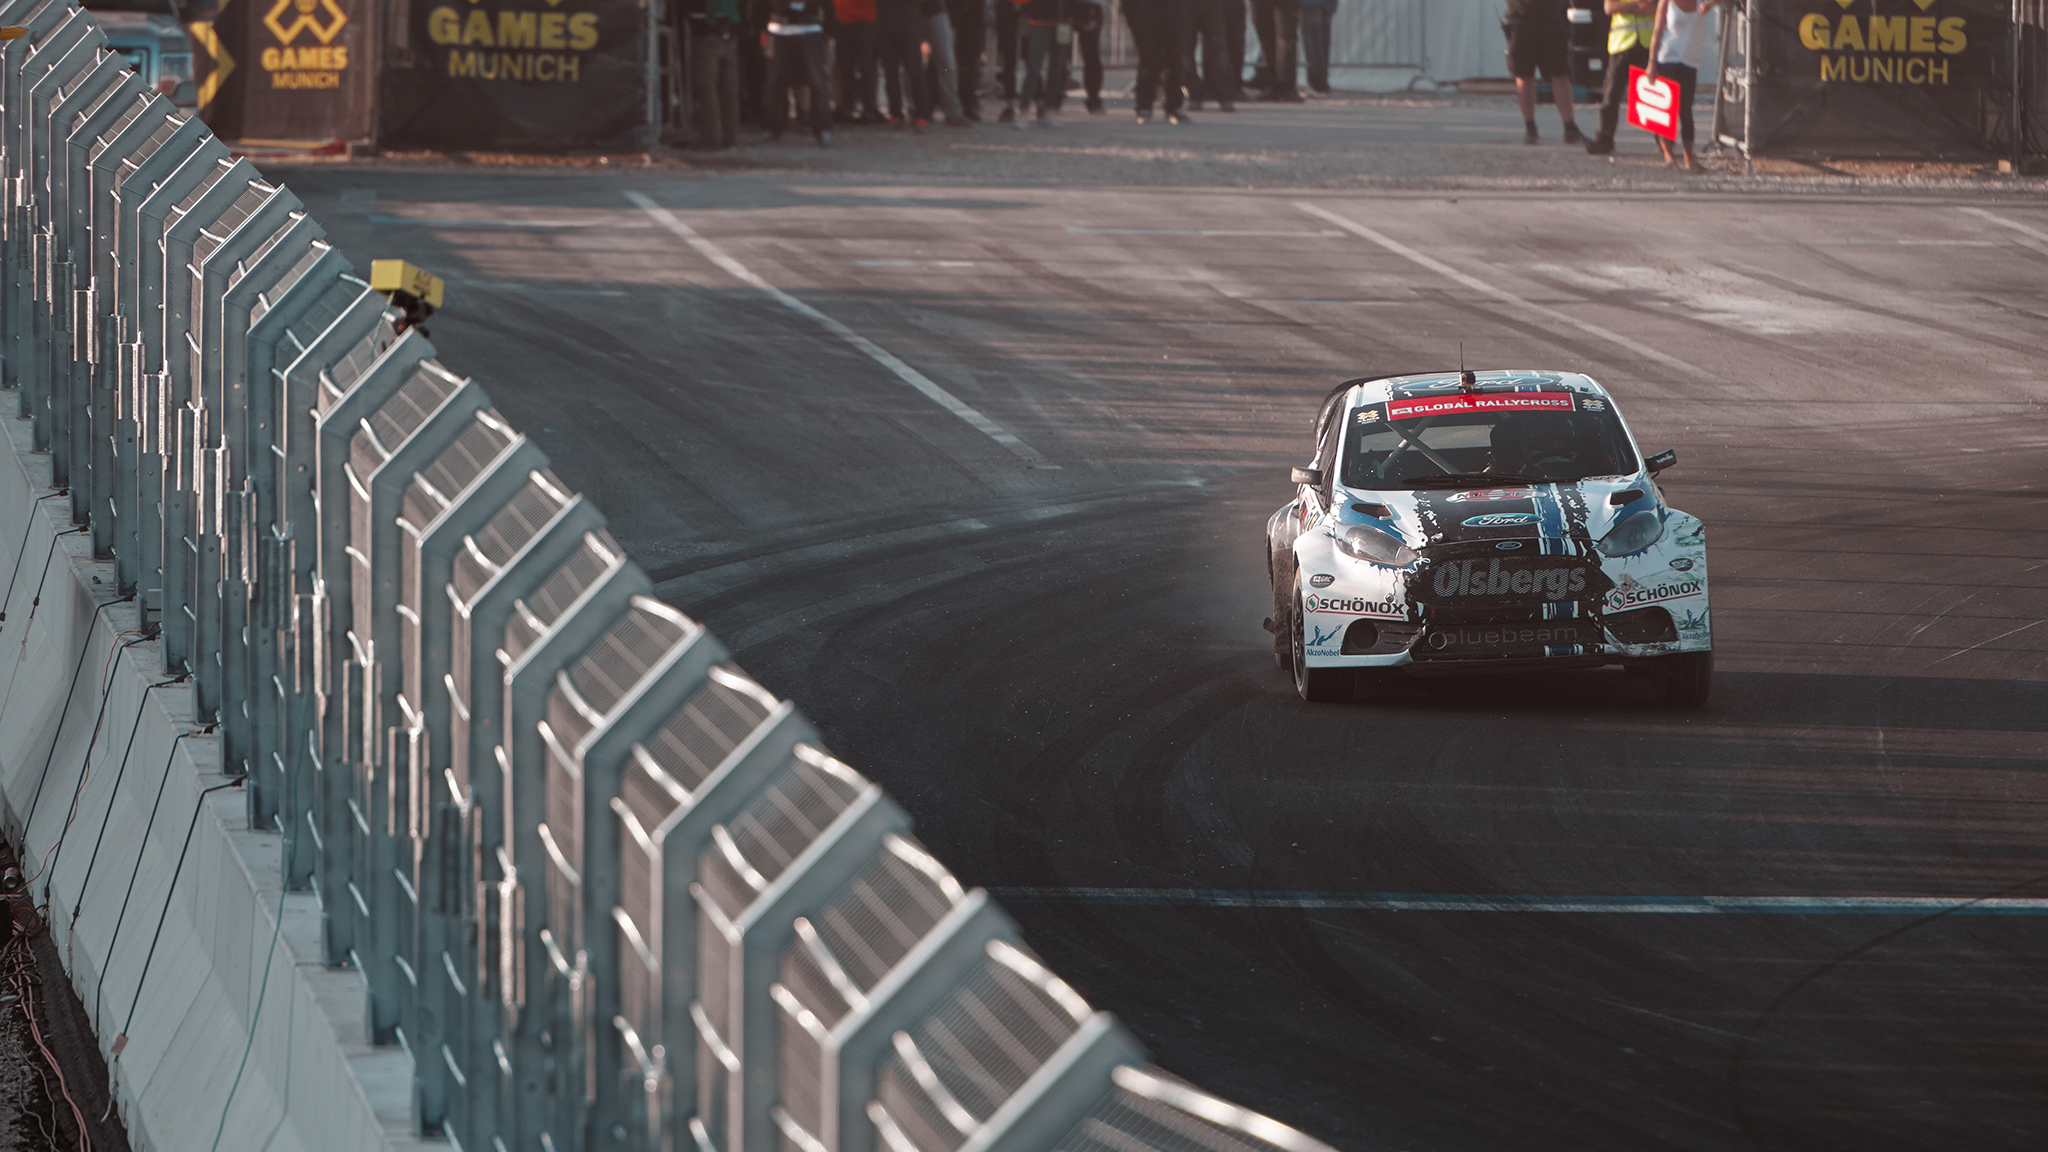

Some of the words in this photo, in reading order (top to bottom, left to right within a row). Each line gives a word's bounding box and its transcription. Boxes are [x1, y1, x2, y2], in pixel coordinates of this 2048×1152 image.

[428, 6, 599, 50] GAMES
[1798, 12, 1967, 54] GAMES
[261, 46, 348, 71] GAMES
[449, 50, 580, 81] MUNICH
[1820, 54, 1948, 85] MUNICH
[272, 72, 339, 89] MUNICH
[1635, 75, 1672, 127] 10
[1414, 399, 1473, 412] GLOBAL
[1475, 398, 1569, 408] RALLYCROSS
[1478, 515, 1529, 526] Ford
[1433, 558, 1586, 600] Olsbergs
[1626, 580, 1702, 604] SCHÖNOX
[1320, 597, 1404, 614] SCHÖNOX
[1306, 648, 1340, 657] AkzoNobel
